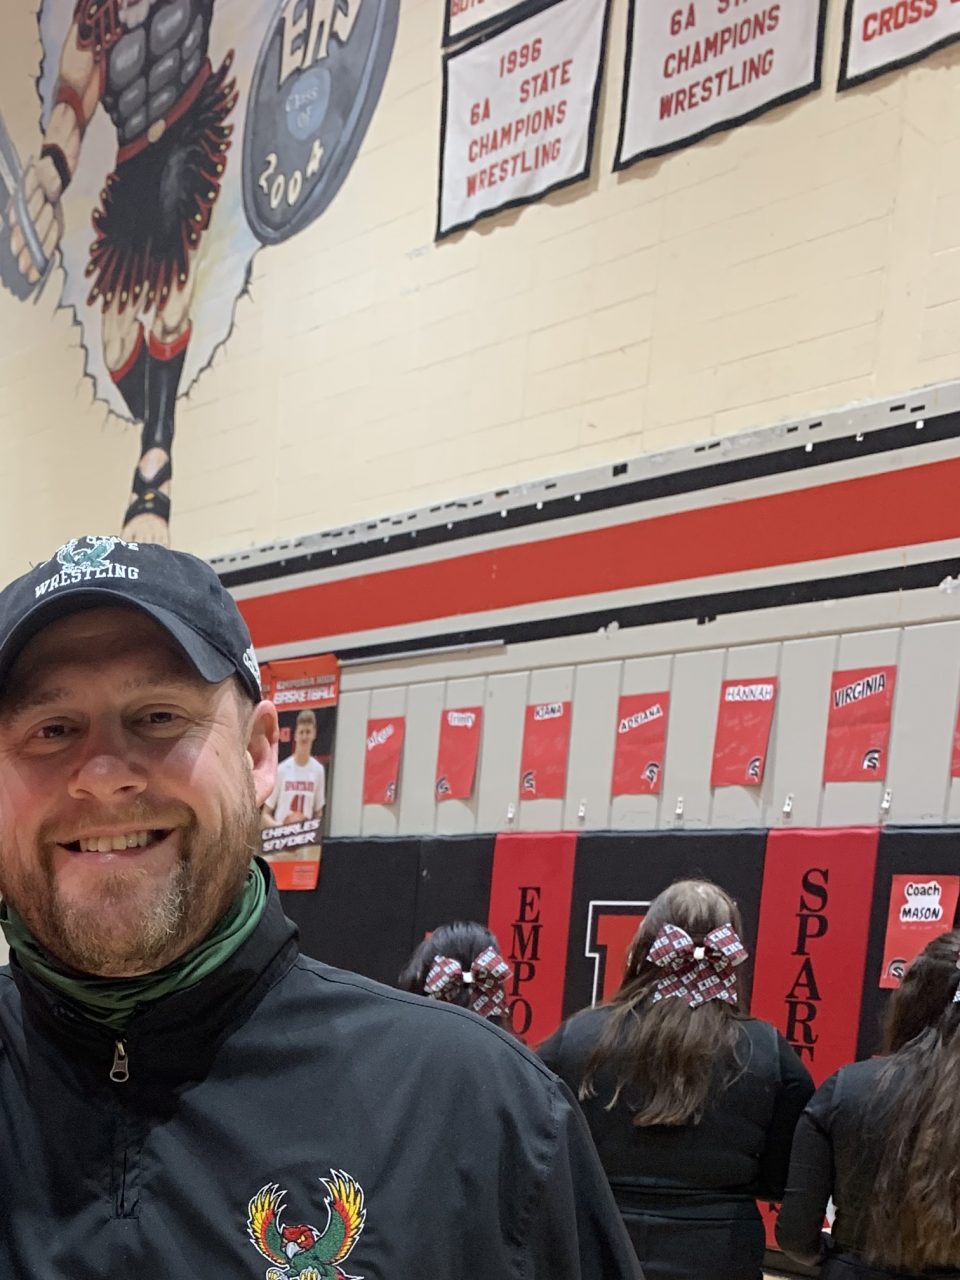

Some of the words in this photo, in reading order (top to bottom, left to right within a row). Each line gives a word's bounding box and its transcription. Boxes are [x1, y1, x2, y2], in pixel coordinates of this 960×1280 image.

[670, 2, 695, 36] 6A
[863, 0, 937, 41] CROSS
[499, 38, 542, 77] 1996
[663, 4, 780, 78] CHAMPIONS
[470, 97, 490, 125] 6A
[520, 59, 573, 103] STATE
[659, 48, 774, 120] WRESTLING
[468, 100, 567, 163] CHAMPIONS
[467, 138, 561, 198] WRESTLING
[35, 563, 139, 598] WRESTLING
[726, 686, 772, 700] HANNAH
[834, 673, 886, 708] VIRGINIA
[620, 706, 661, 732] ADRIANA
[262, 819, 320, 840] CHARLES
[263, 832, 317, 852] SNYDER
[906, 883, 940, 897] Coach
[902, 907, 940, 920] MASON
